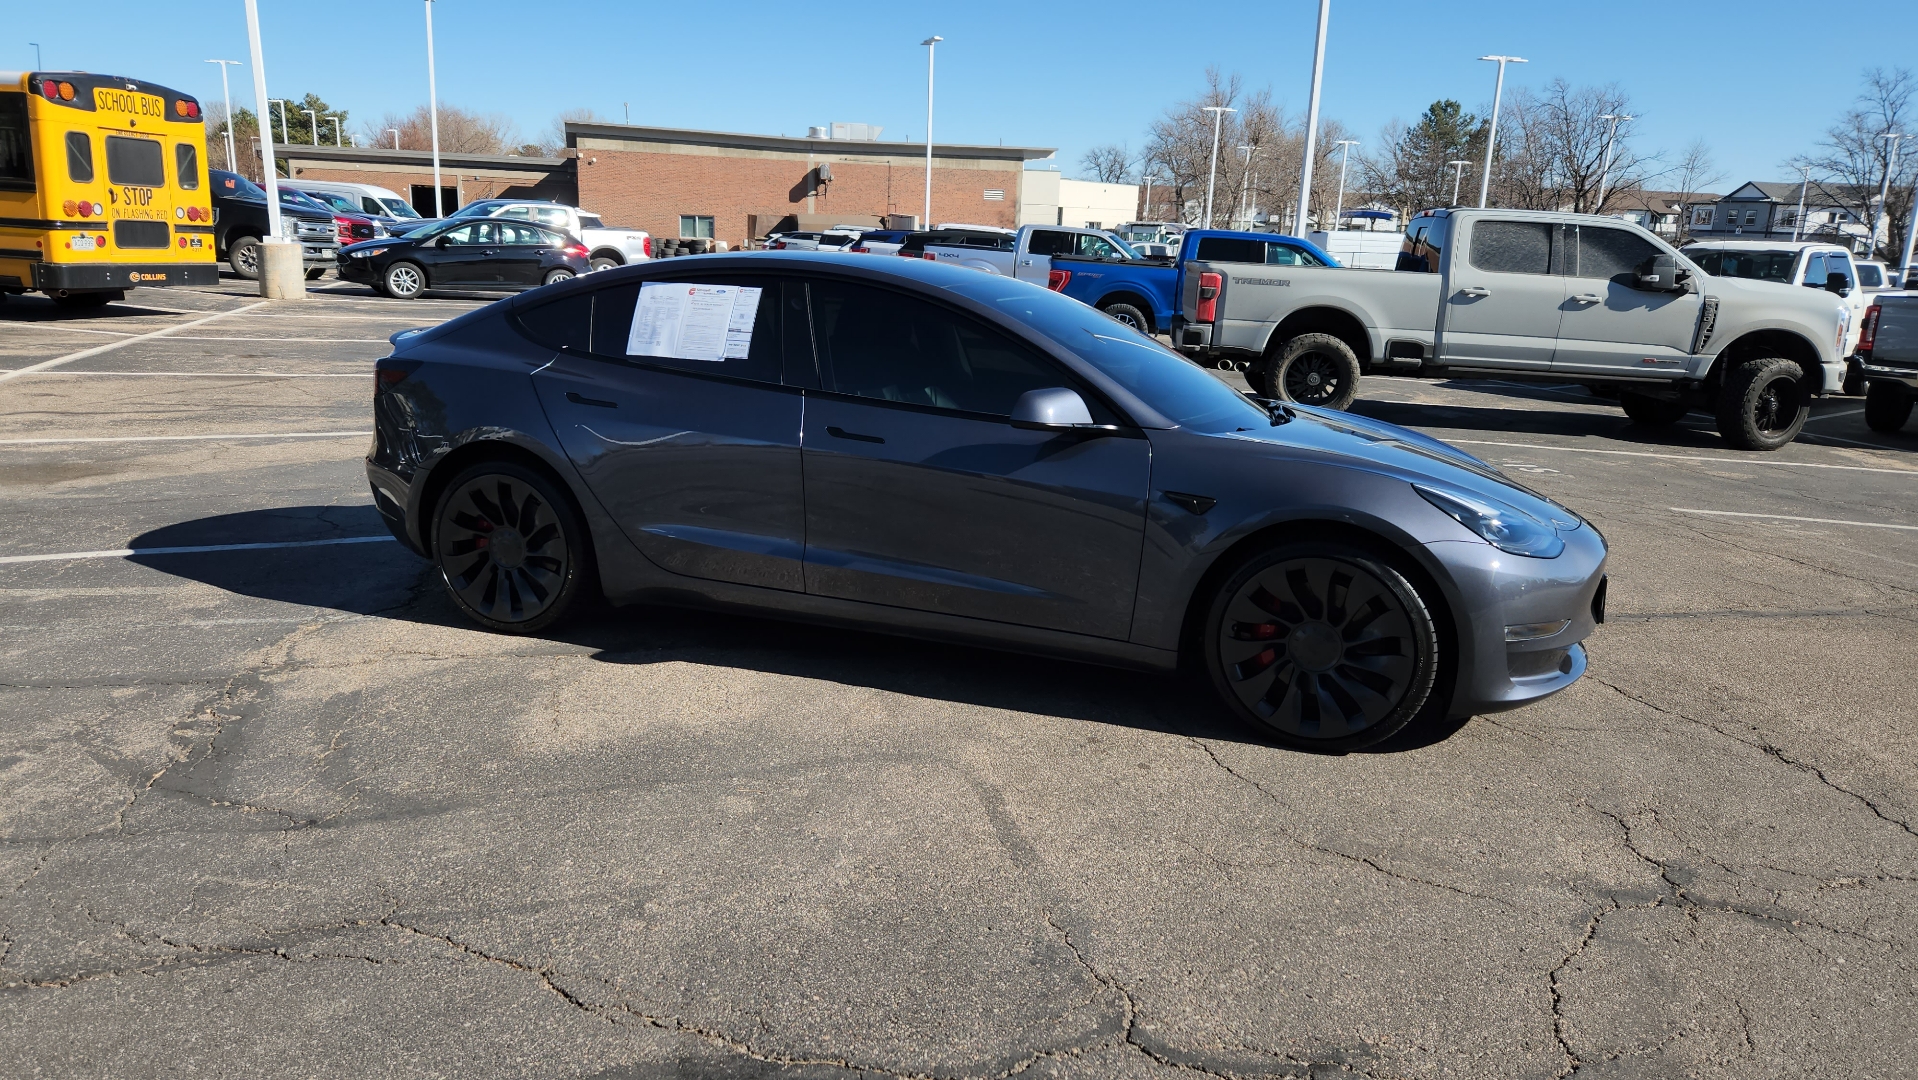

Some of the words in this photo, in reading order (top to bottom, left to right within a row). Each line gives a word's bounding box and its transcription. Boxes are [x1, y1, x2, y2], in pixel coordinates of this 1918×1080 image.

[98, 91, 139, 115] SCHOOL
[141, 96, 161, 118] BUS
[123, 186, 153, 207] STOP
[111, 207, 121, 219] ON
[123, 208, 154, 220] FLASHING
[156, 210, 168, 220] RED
[141, 273, 167, 281] COLLINS
[1232, 276, 1291, 288] TREMOR
